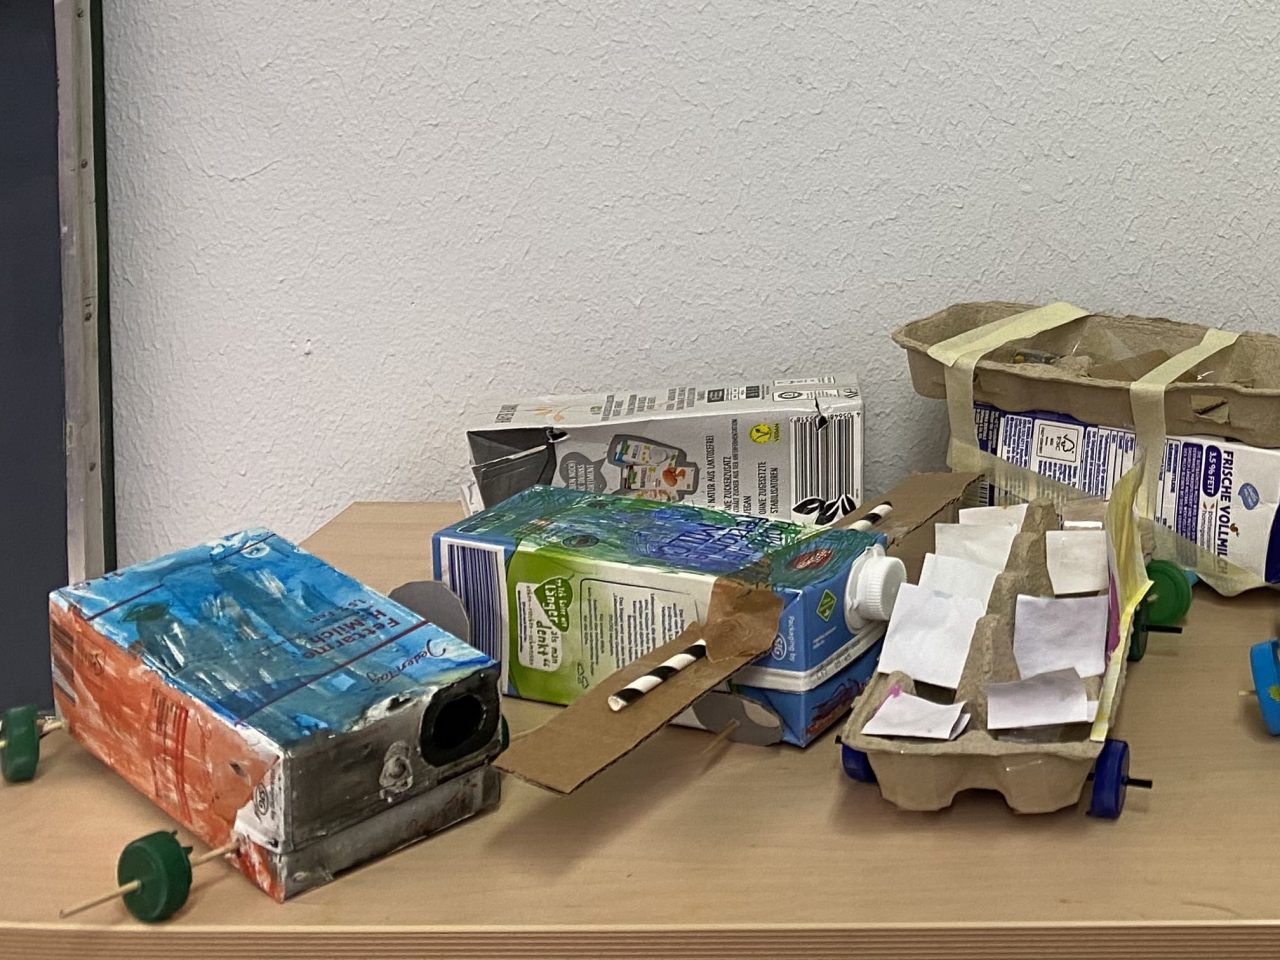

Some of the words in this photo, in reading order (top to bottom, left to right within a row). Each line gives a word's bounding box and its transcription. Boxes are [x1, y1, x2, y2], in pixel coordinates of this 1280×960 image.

[707, 470, 715, 482] AUS
[722, 455, 732, 498] ZUCKERZUSATZ
[757, 461, 767, 497] ZUGESETZTE
[1207, 476, 1216, 495] FETT
[1220, 450, 1234, 503] FRISCHE
[707, 483, 716, 504] NATUR
[769, 467, 779, 514] STABILISATOREN
[758, 497, 767, 515] OHNE
[303, 617, 401, 660] Fettarme
[773, 637, 784, 657] SIG
[787, 615, 795, 651] Packaging
[789, 653, 796, 663] by
